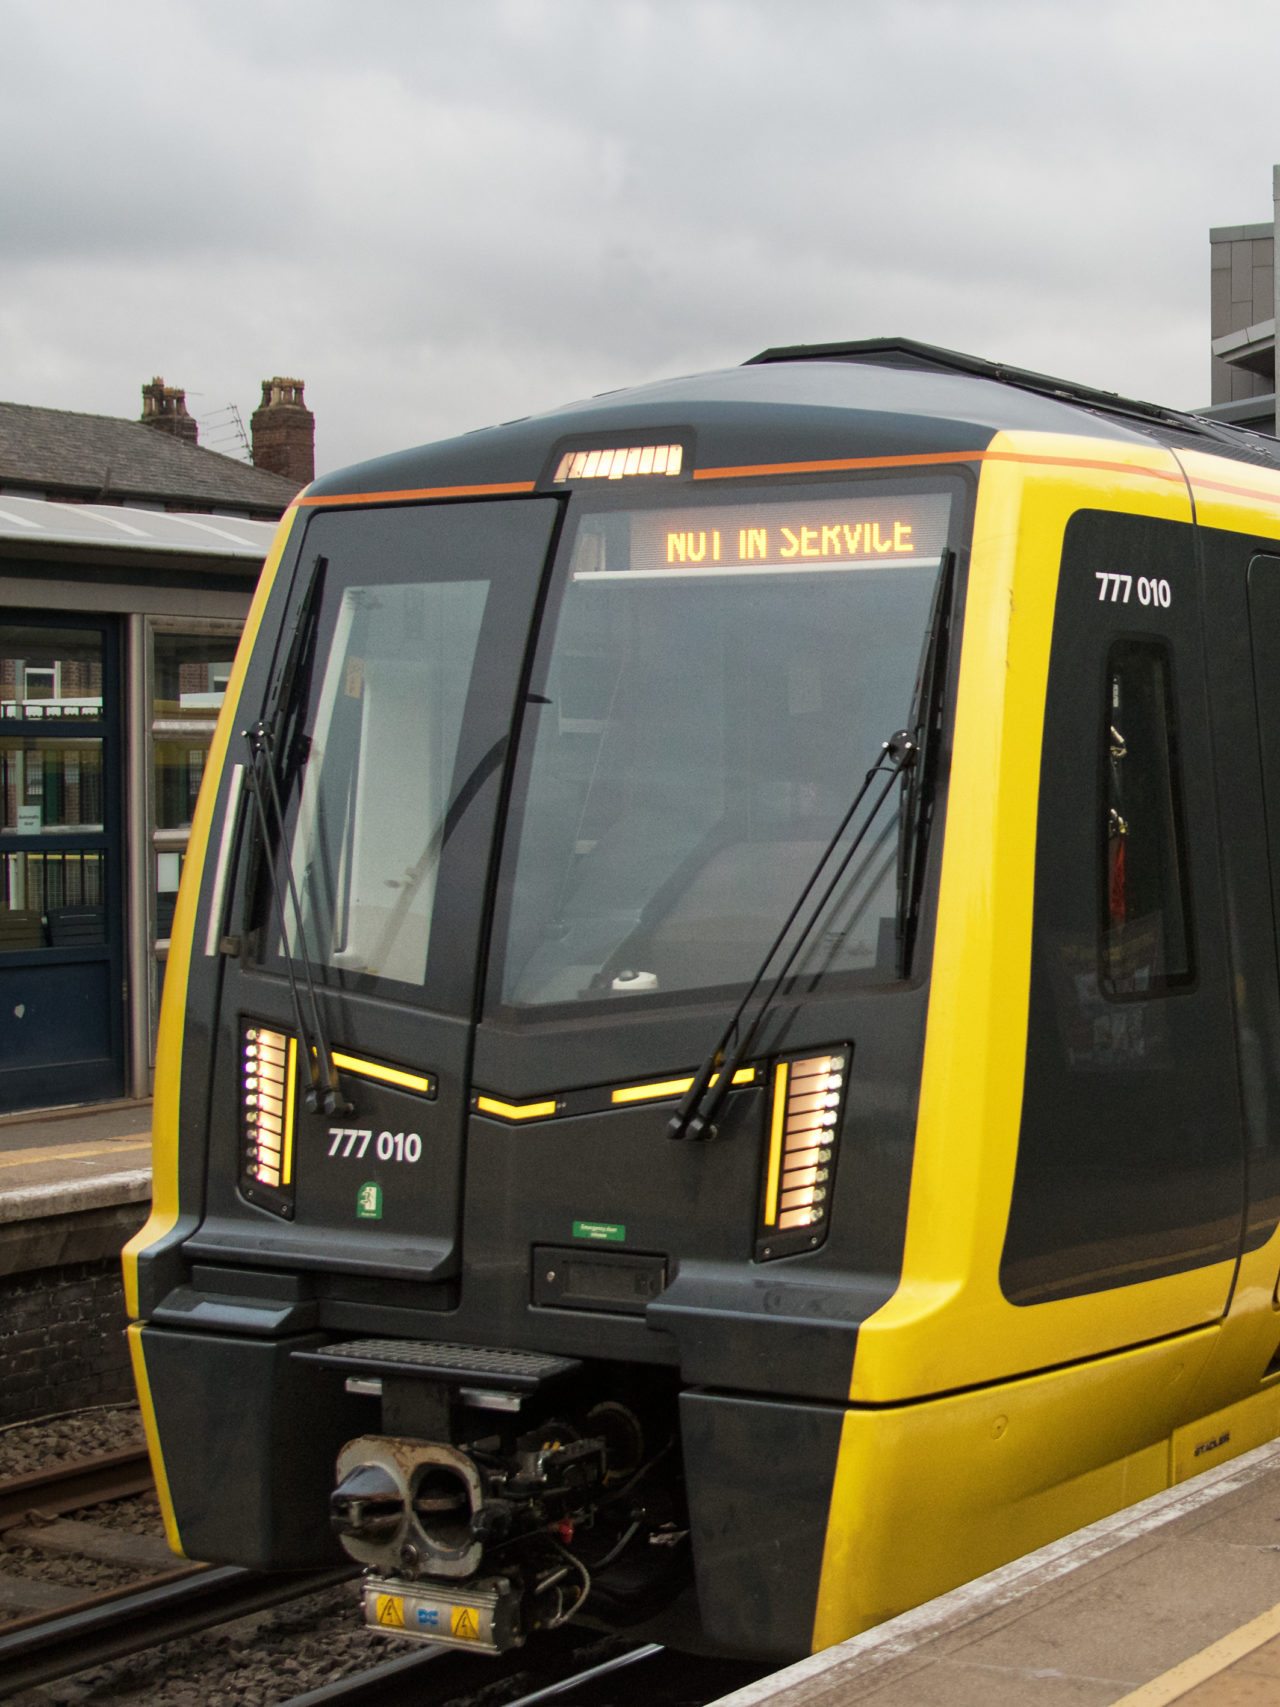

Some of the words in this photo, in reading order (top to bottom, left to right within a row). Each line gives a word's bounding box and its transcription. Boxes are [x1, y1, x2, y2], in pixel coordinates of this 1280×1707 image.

[739, 528, 767, 560] IN
[1095, 571, 1132, 603] 777
[1137, 576, 1171, 608] 010
[328, 1127, 373, 1158] 777
[376, 1130, 422, 1162] 010
